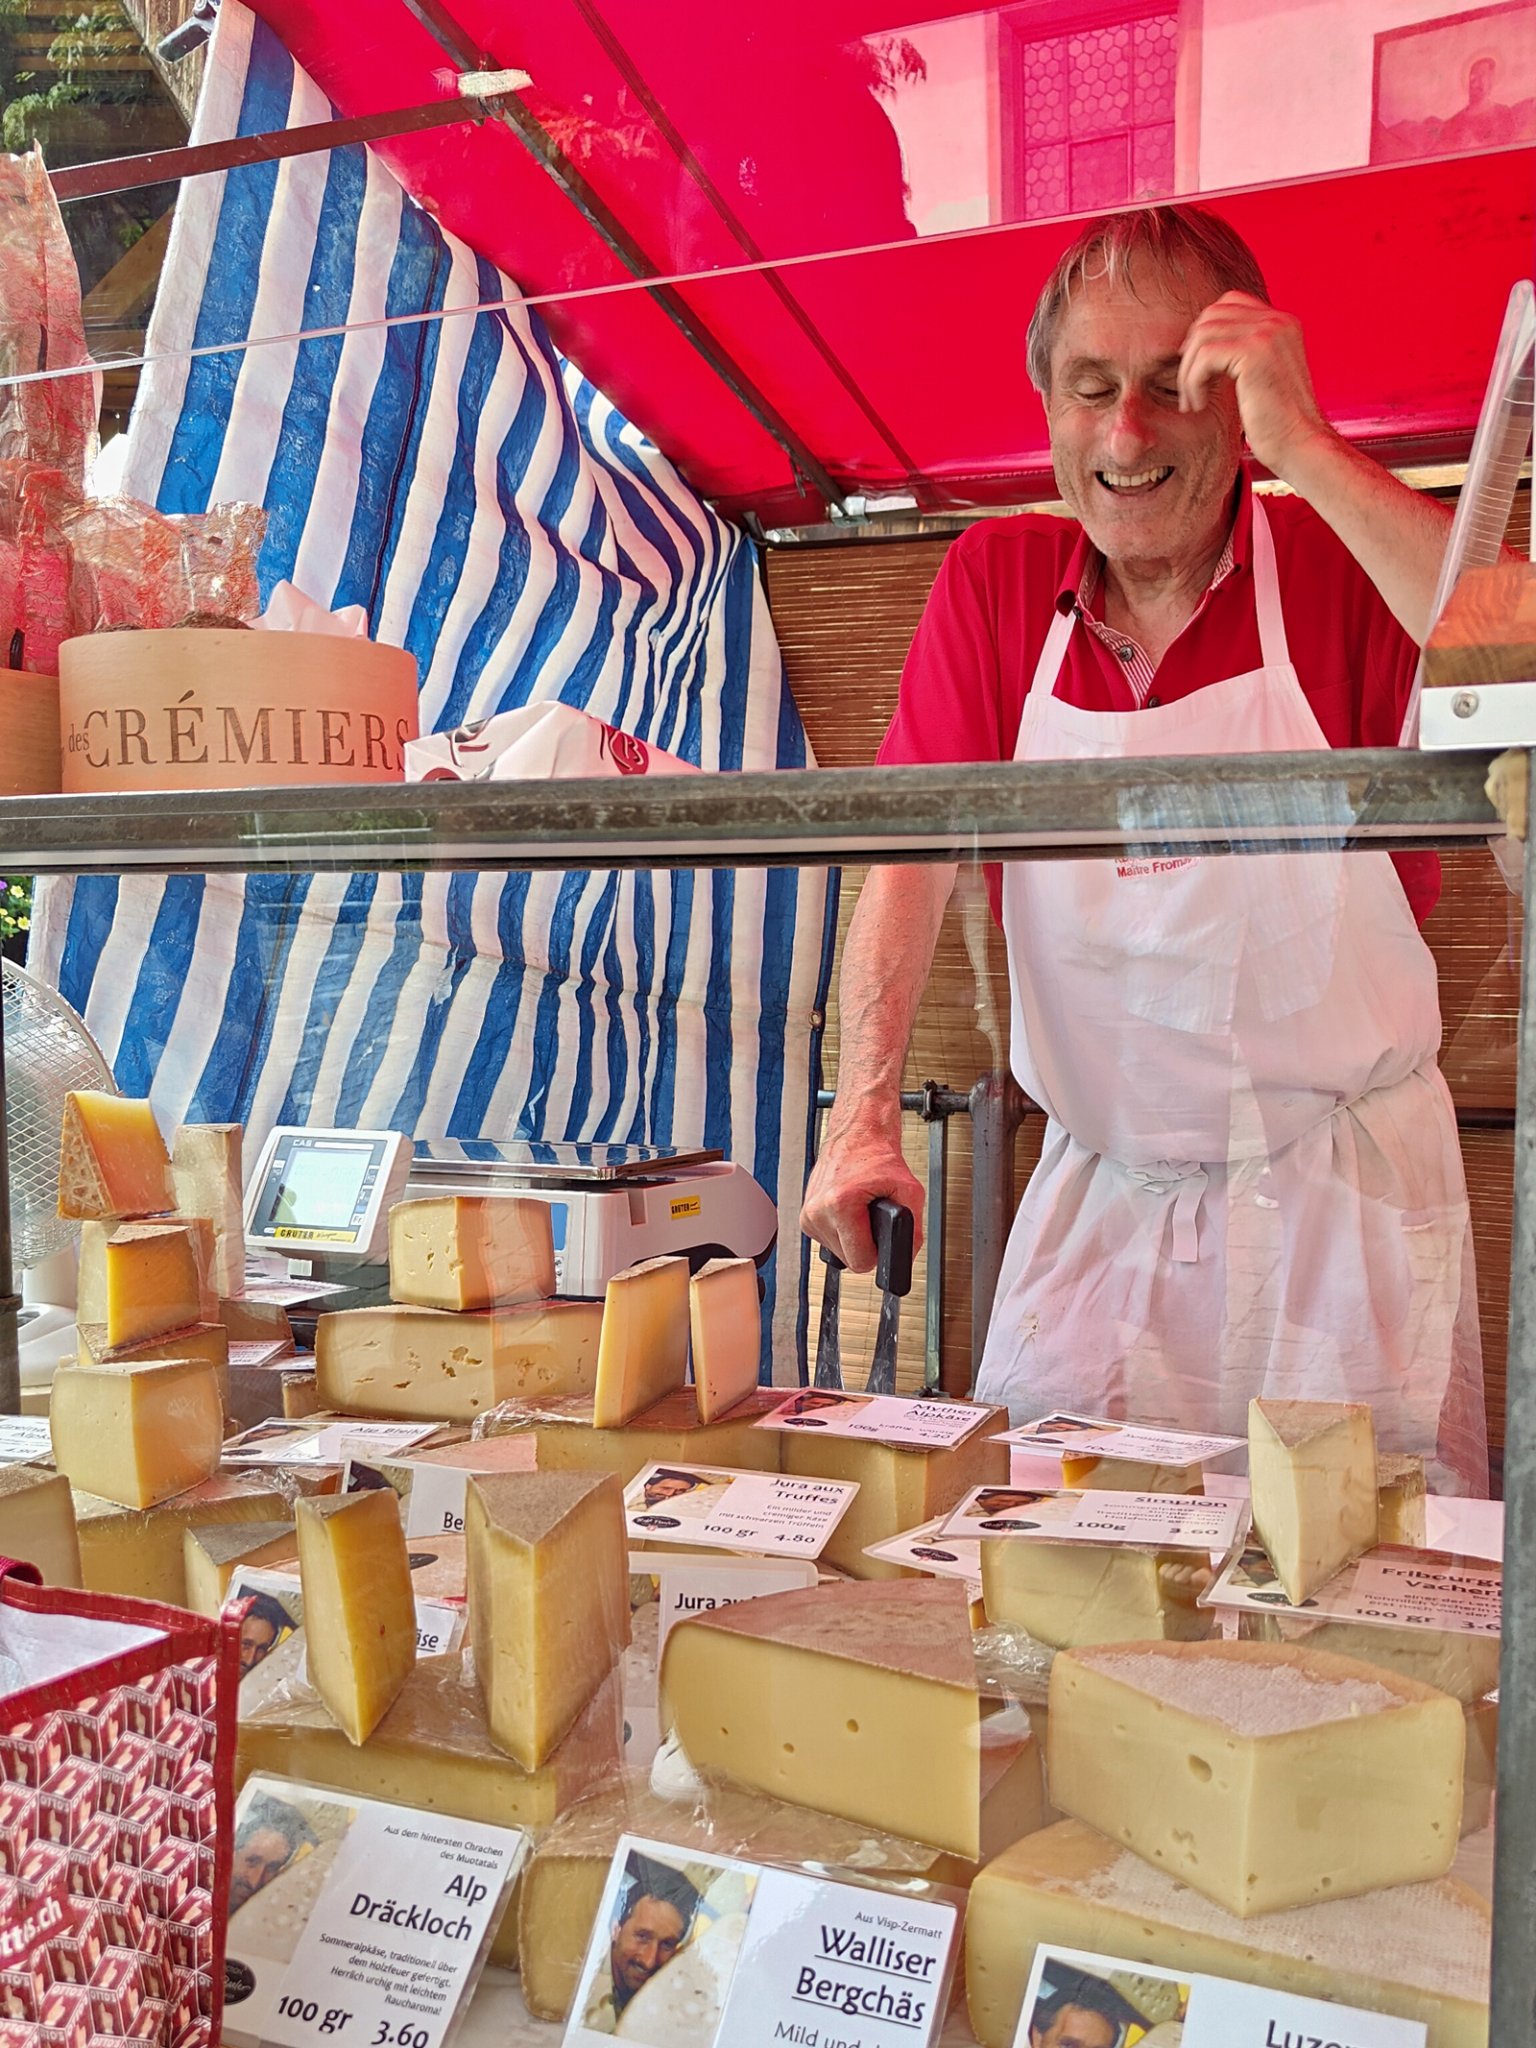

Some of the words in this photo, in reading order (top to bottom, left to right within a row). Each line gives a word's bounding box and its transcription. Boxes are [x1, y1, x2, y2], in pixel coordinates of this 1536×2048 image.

[68, 723, 90, 753] des
[913, 1403, 977, 1416] Mythen
[769, 1479, 808, 1490] Jura
[812, 1484, 845, 1494] aux
[775, 1490, 839, 1504] Truffes
[1134, 1496, 1228, 1508] Simplon
[703, 1524, 733, 1534] 100
[735, 1529, 759, 1538] gr
[774, 1534, 816, 1544] 4.80
[1074, 1521, 1127, 1532] 100g
[1169, 1527, 1219, 1535] 3.60
[674, 1592, 717, 1610] Jura
[1354, 1608, 1398, 1619] 100
[1405, 1614, 1436, 1623] gr
[384, 1825, 400, 1835] Aus
[401, 1828, 419, 1839] dem
[420, 1831, 463, 1849] hintersten
[464, 1841, 504, 1857] Chrachen
[439, 1849, 455, 1861] des
[444, 1874, 488, 1907] Alp
[349, 1892, 473, 1942] Dräckloch
[854, 1910, 874, 1924] Aus
[876, 1915, 943, 1940] Visp-Zermatt
[389, 1950, 437, 1969] traditionell
[820, 1924, 937, 1977] Walliser
[348, 1954, 368, 1967] dem
[369, 1959, 411, 1978] Holzfeuer
[365, 1974, 393, 1991] urchig
[393, 1981, 408, 1993] mit
[409, 1983, 447, 2001] leichtem
[795, 1965, 927, 2023] Bergchäs
[277, 1995, 319, 2022] 100
[318, 2007, 353, 2035] gr
[371, 2019, 430, 2048] 3.60
[773, 2020, 820, 2048] Mild
